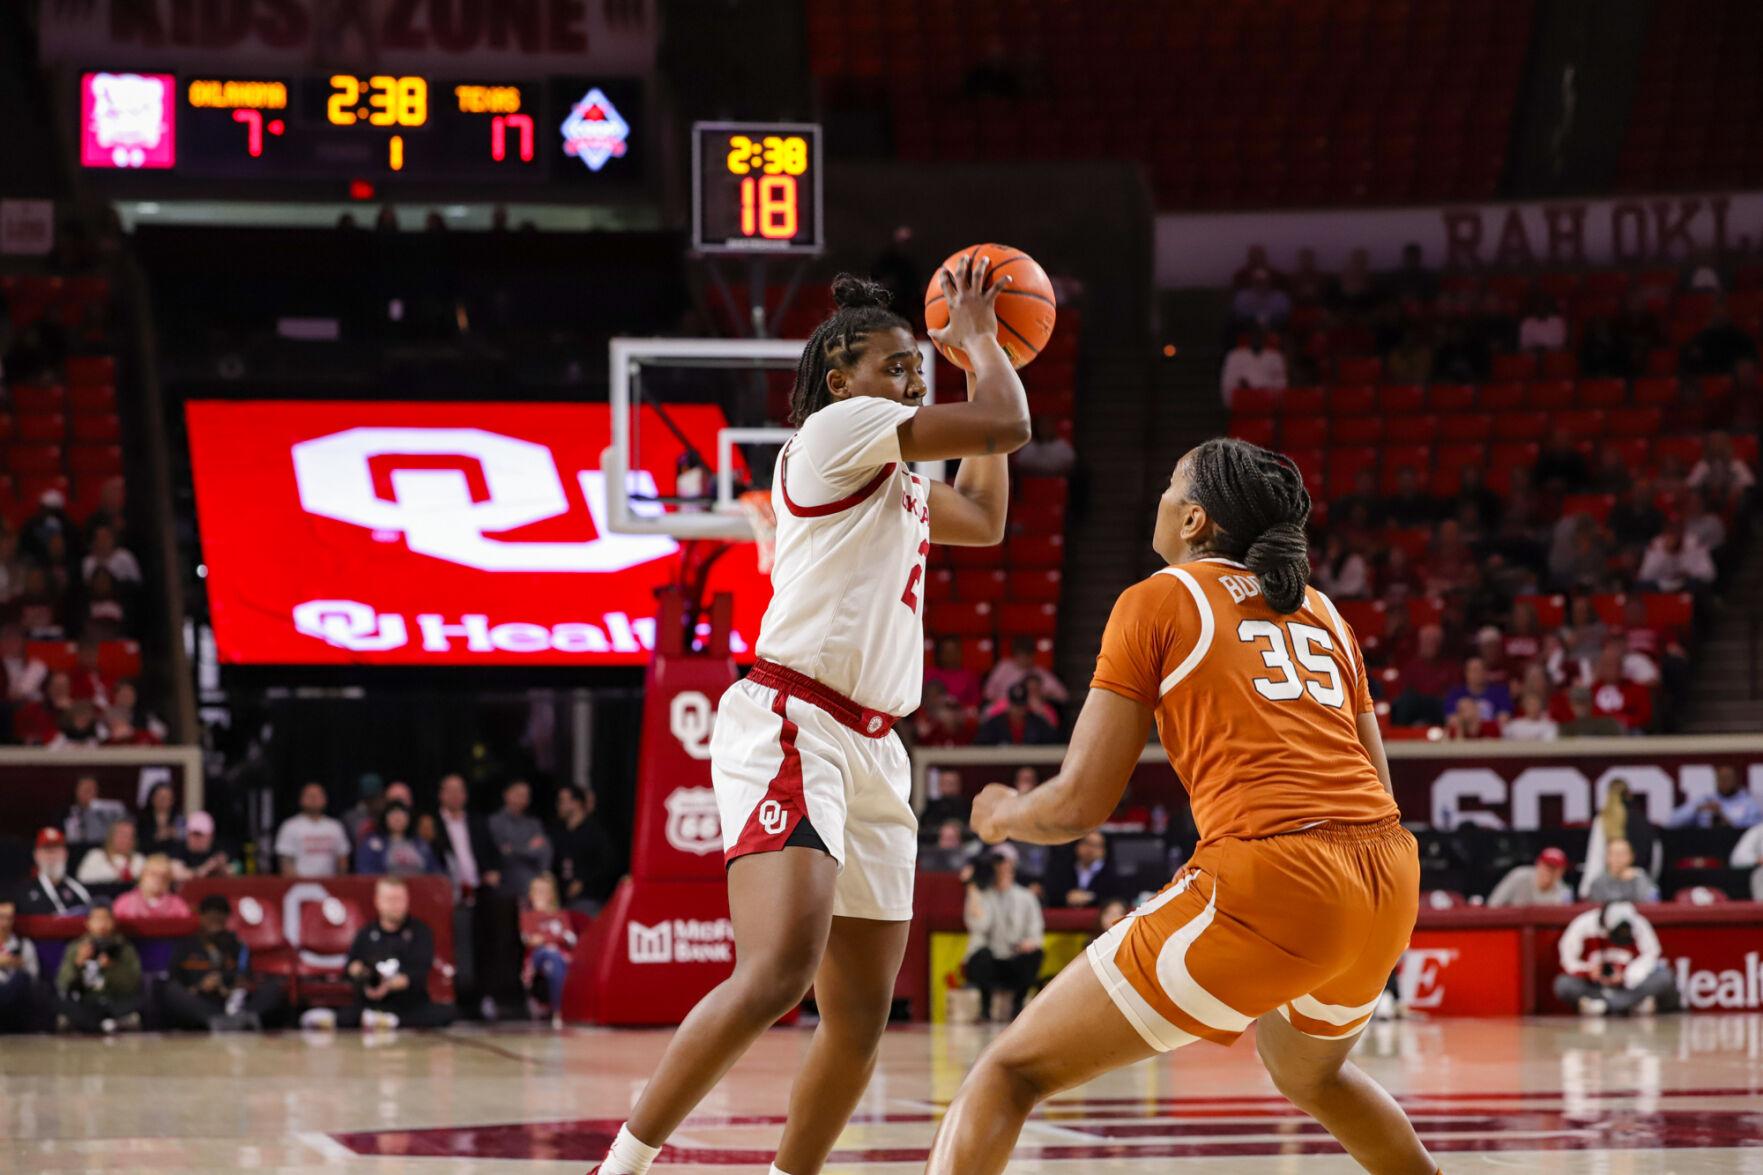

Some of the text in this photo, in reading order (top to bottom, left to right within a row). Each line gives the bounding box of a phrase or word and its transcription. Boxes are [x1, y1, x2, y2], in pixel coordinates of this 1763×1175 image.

[328, 75, 427, 126] 2:38
[389, 135, 403, 171] 1
[491, 114, 534, 162] 17
[727, 135, 807, 175] 2:38
[741, 174, 798, 239] 18
[293, 600, 407, 651] OU
[1236, 619, 1345, 709] 35
[759, 800, 788, 834] OU
